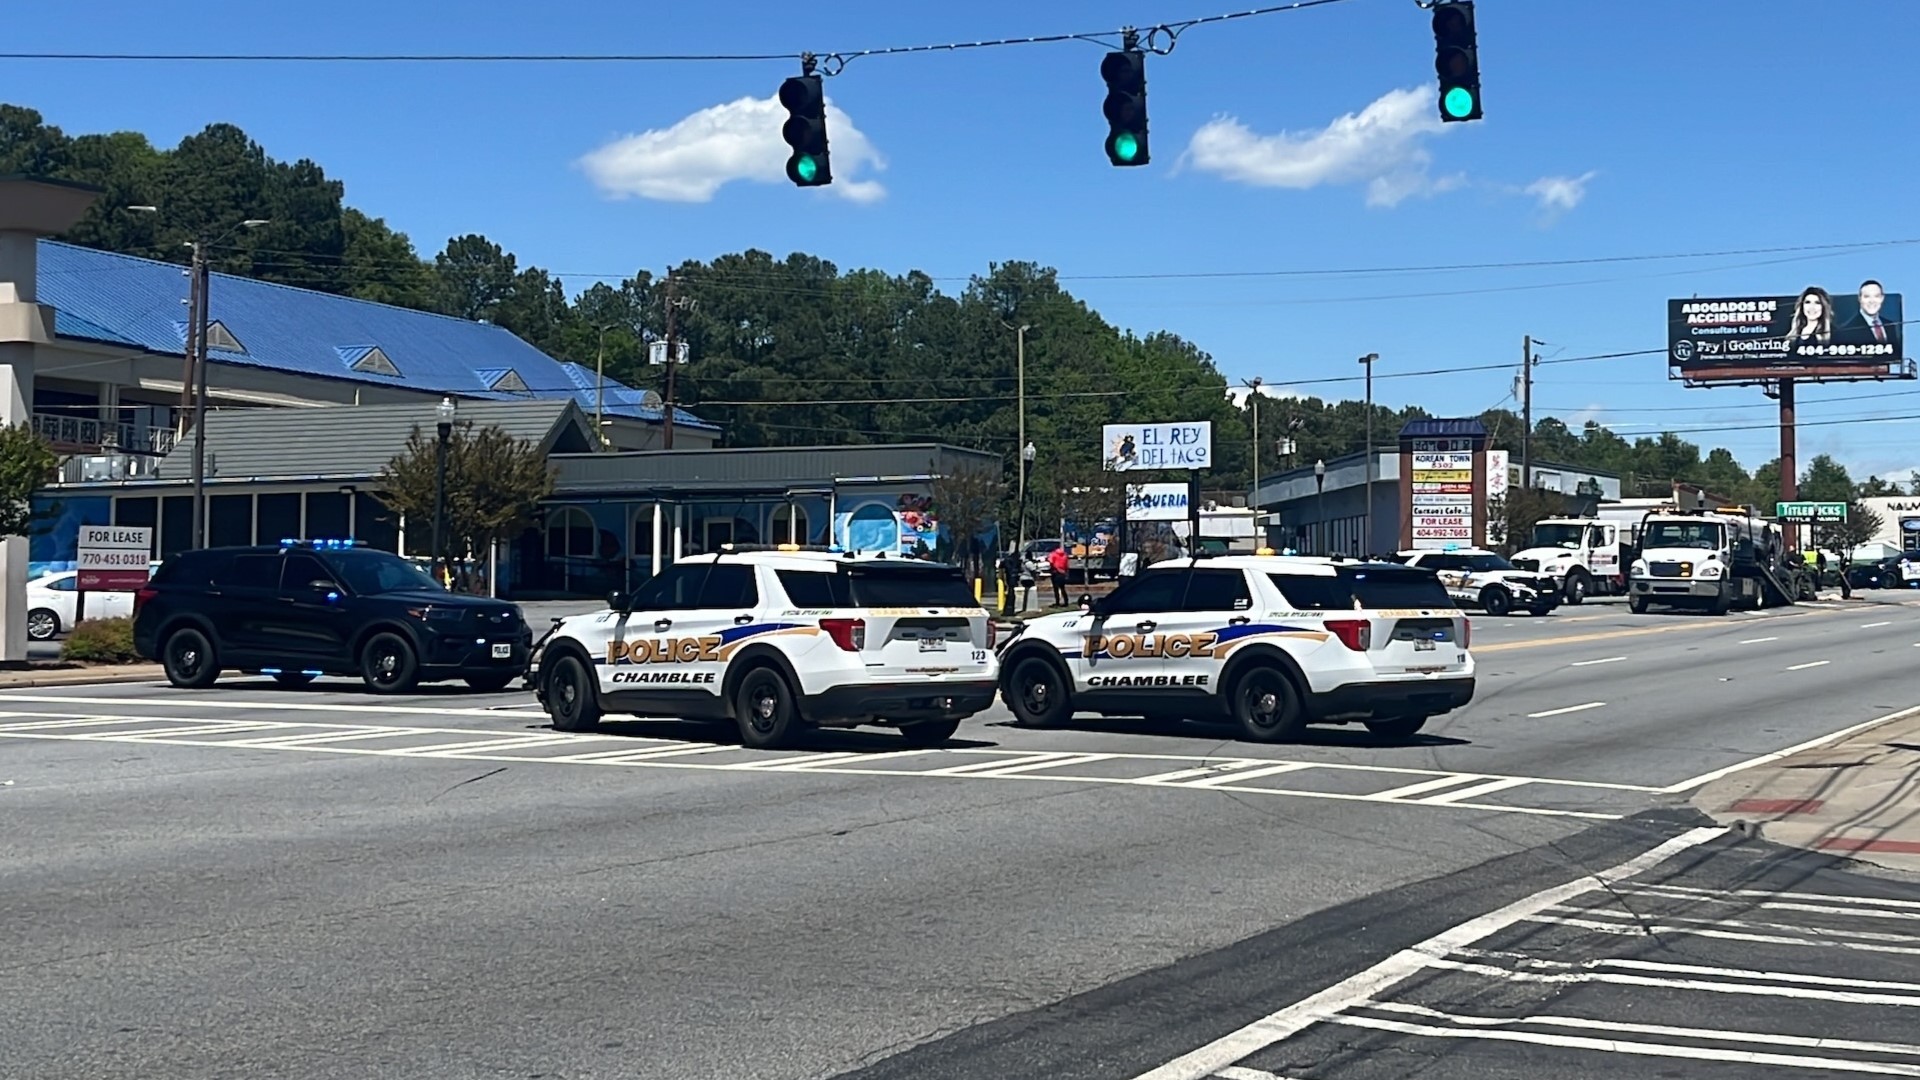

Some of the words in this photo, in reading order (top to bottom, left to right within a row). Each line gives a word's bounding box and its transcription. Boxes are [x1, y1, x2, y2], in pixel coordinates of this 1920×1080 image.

[1682, 302, 1756, 313] ABOGADOS
[1758, 301, 1777, 311] DE
[1687, 311, 1772, 323] ACCIDENTES
[1691, 327, 1738, 335] Consultas
[1739, 325, 1768, 334] Gratis
[1696, 341, 1720, 353] Fry
[1728, 339, 1790, 351] Goehring
[1796, 344, 1894, 356] 404-969-1284
[1142, 428, 1164, 445] EL
[1169, 427, 1201, 445] REY
[1142, 448, 1168, 465] DEL
[1415, 455, 1445, 463] KOREAN
[1449, 455, 1471, 463] TOWN
[1420, 518, 1437, 526] FOR
[1438, 518, 1463, 526] LEASE
[88, 531, 110, 542] FOR
[112, 531, 143, 543] LEASE
[607, 637, 721, 665] POLICE
[1082, 634, 1216, 658] POLICE
[971, 650, 986, 660] 123
[612, 672, 716, 683] CHAMBLEE
[1087, 675, 1209, 686] CHAMBLEE
